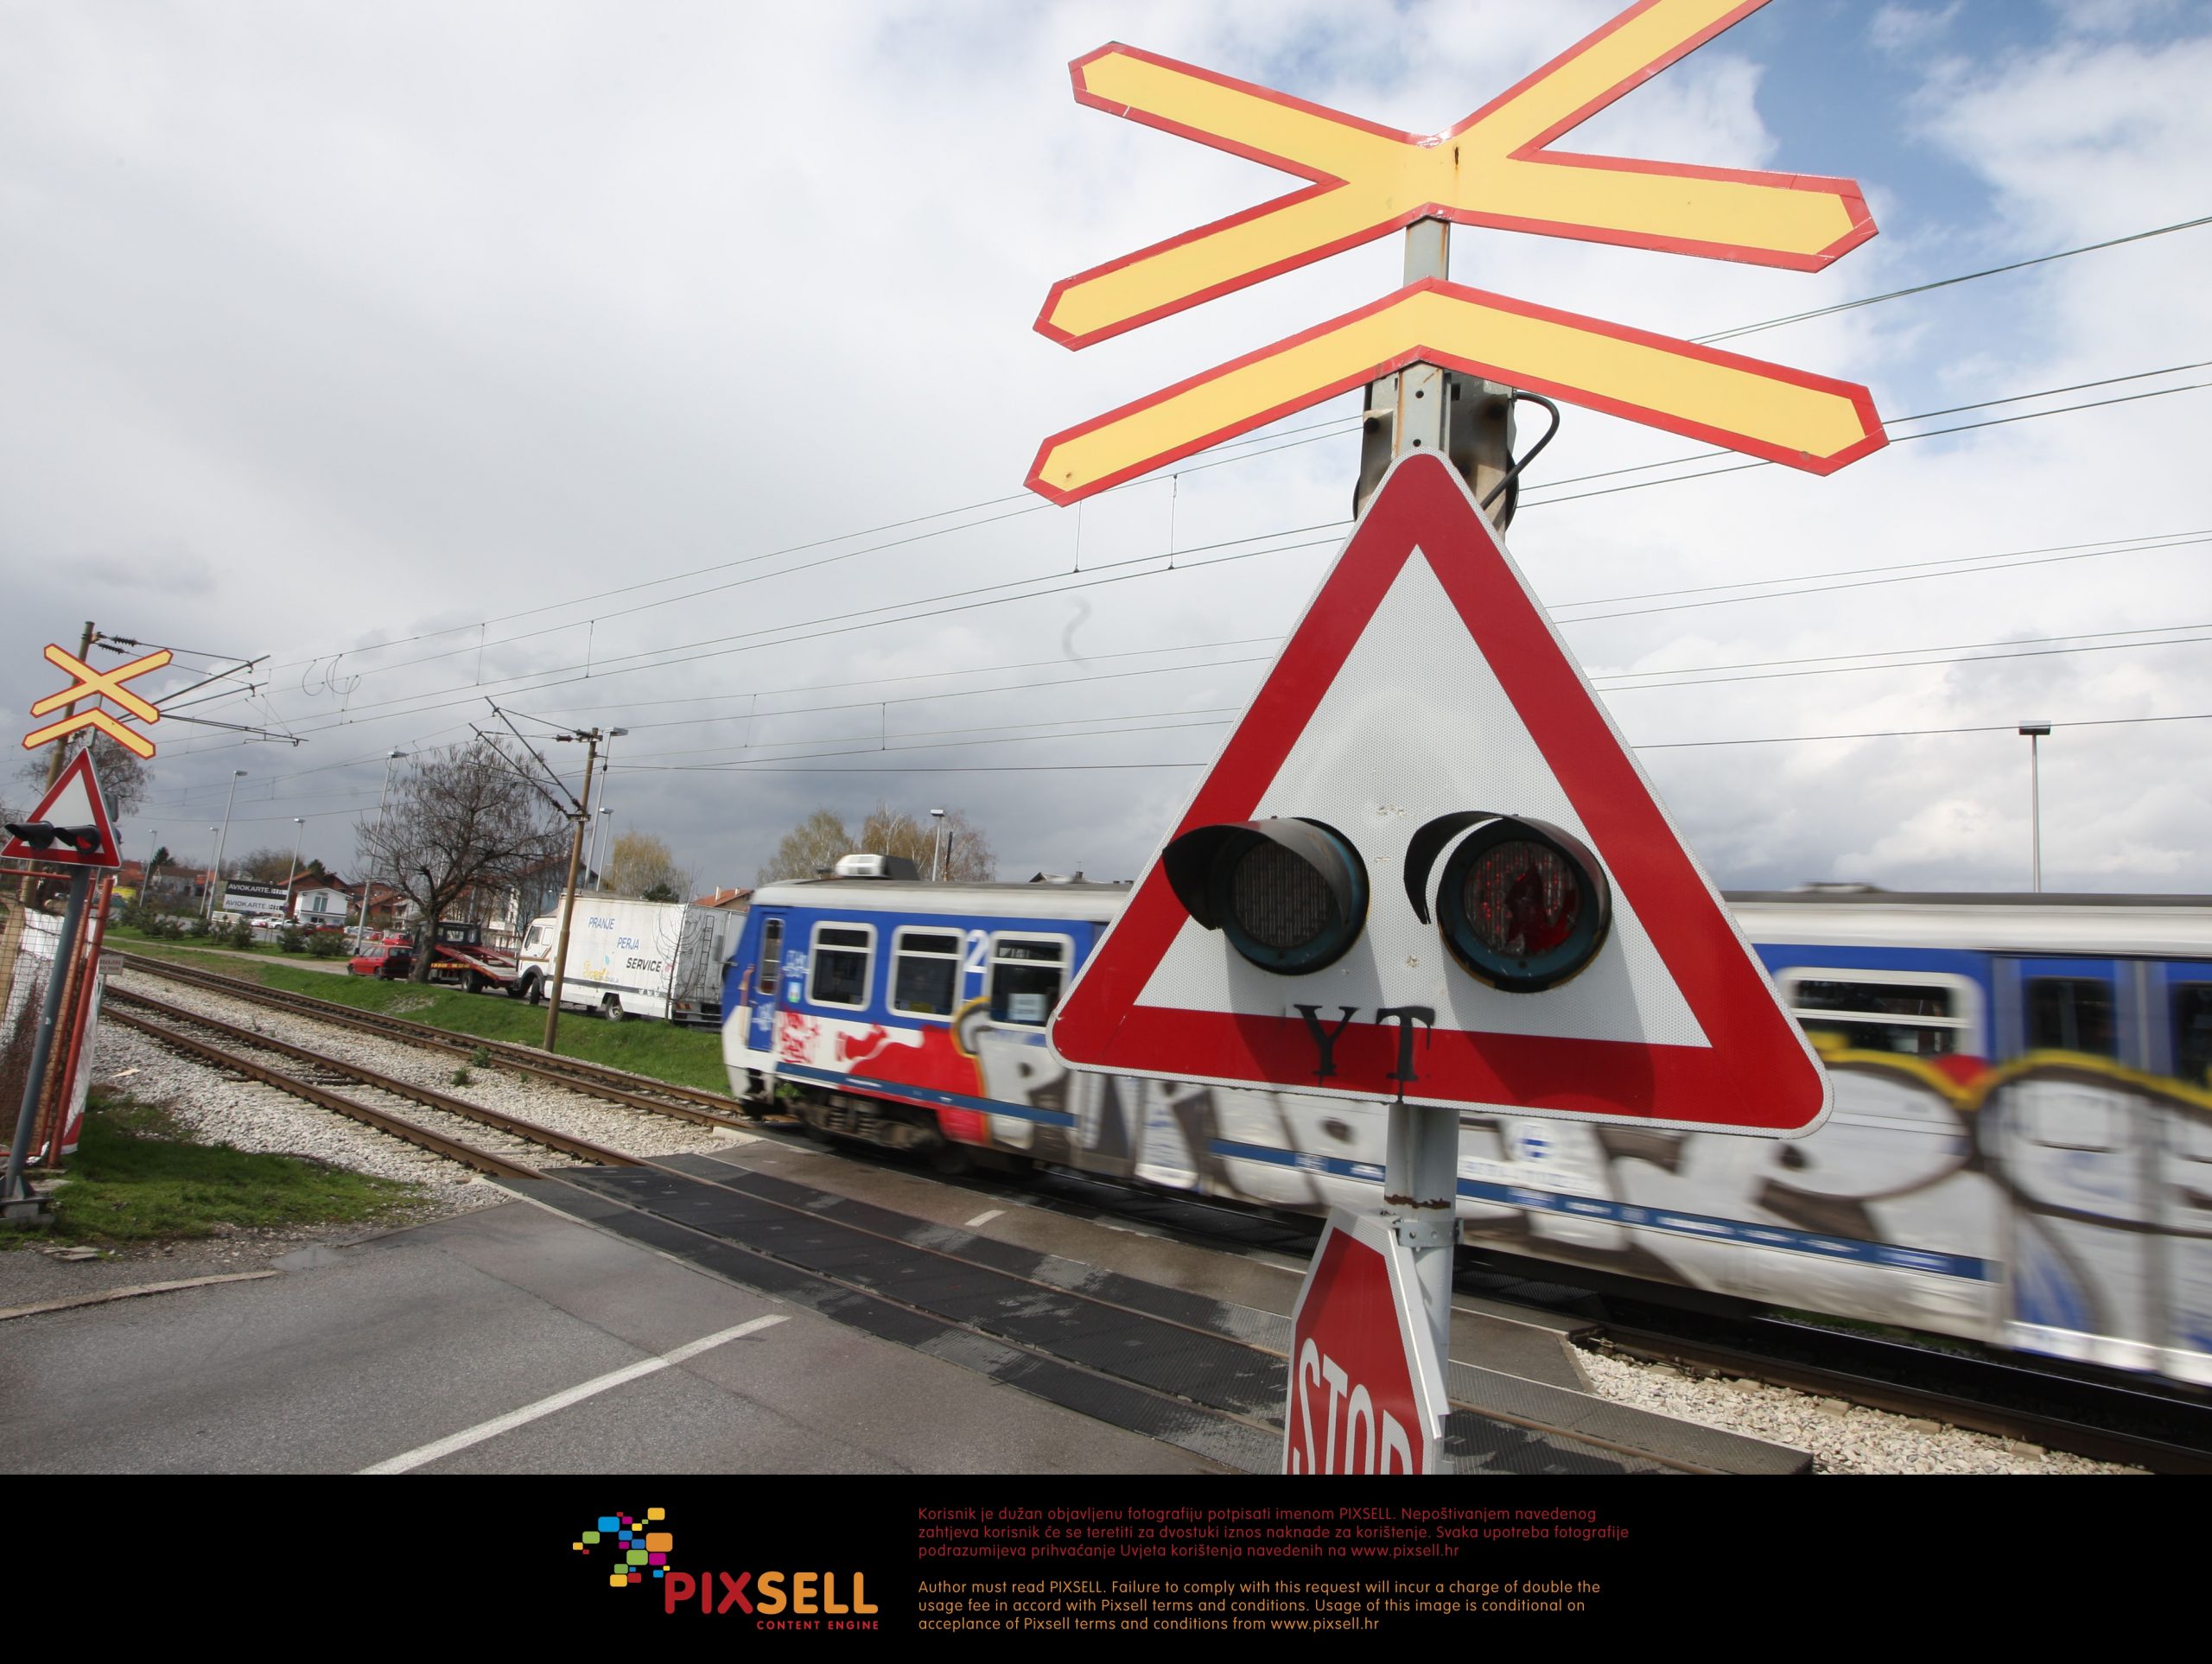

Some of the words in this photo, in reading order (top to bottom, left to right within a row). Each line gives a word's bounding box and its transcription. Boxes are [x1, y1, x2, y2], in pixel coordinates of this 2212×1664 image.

[227, 883, 285, 895] AVIOKARTE.HR
[588, 917, 615, 930] PRANJE
[617, 937, 639, 950] PERJA
[963, 929, 990, 974] 2
[626, 957, 662, 973] SERVICE
